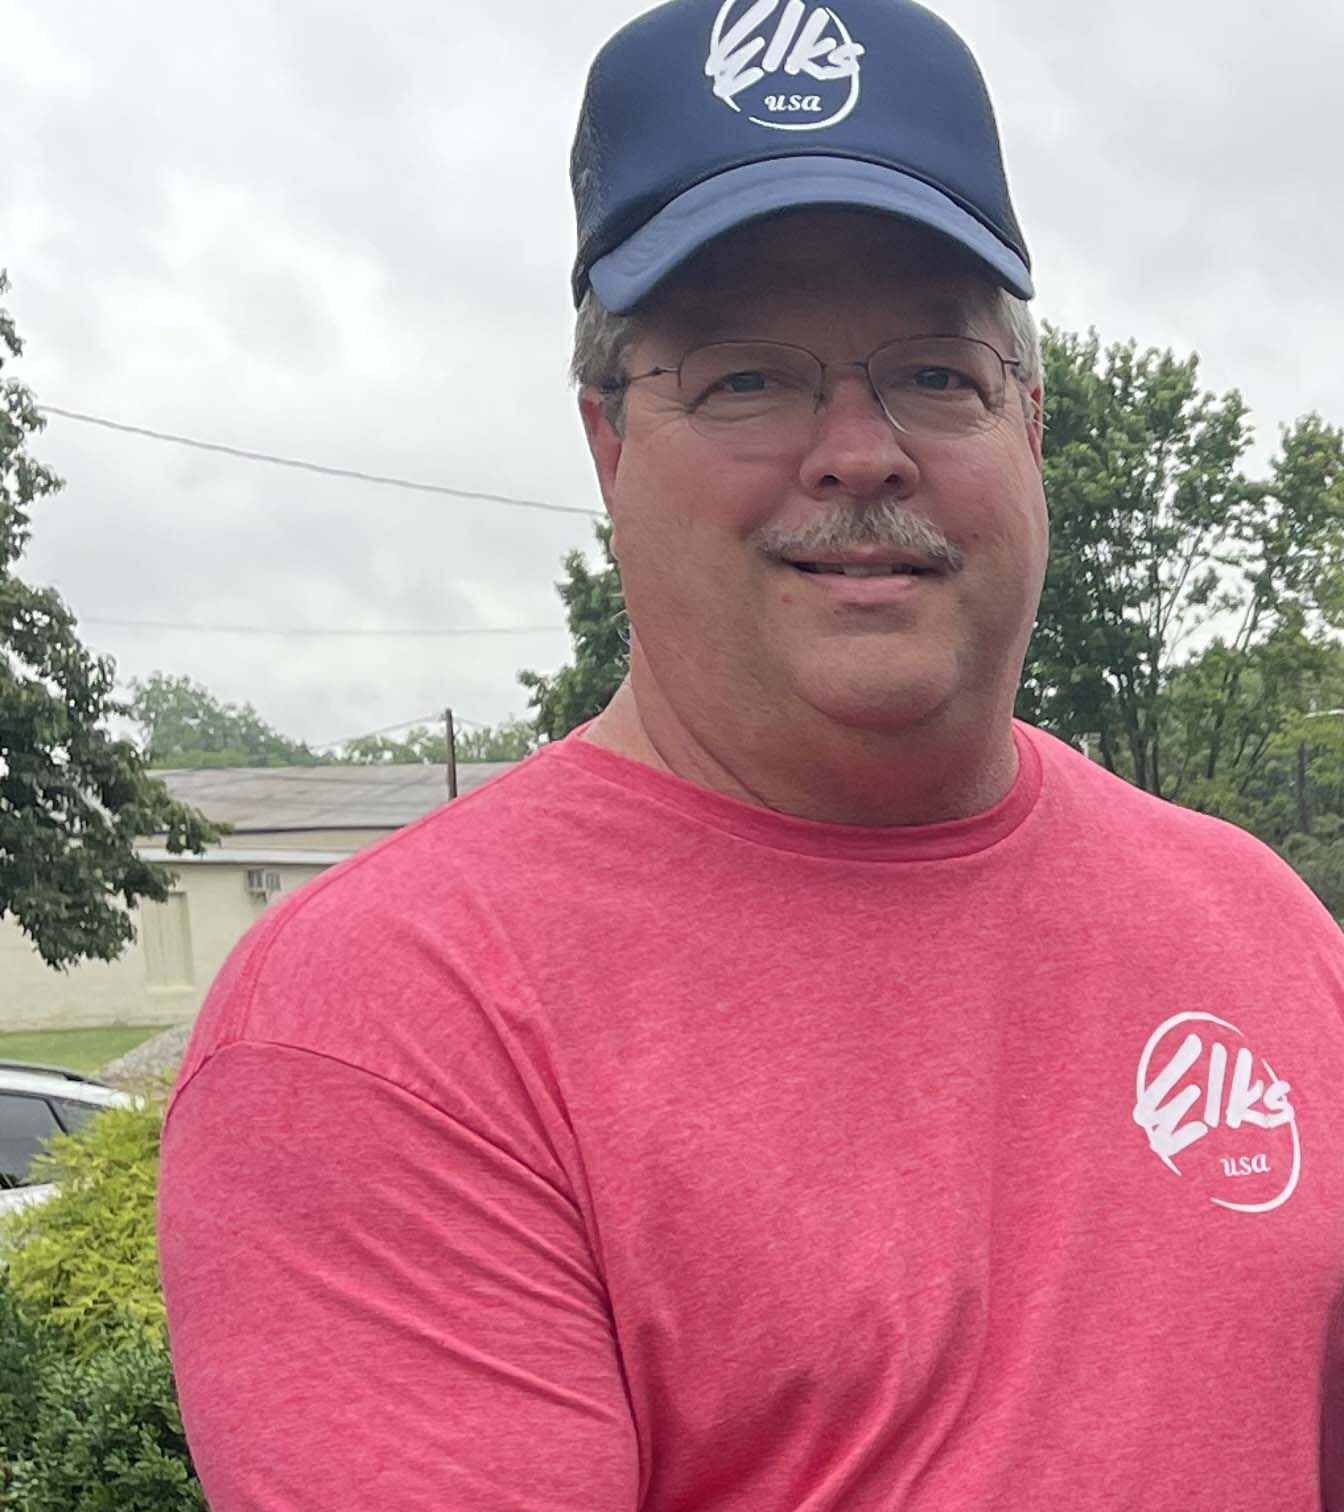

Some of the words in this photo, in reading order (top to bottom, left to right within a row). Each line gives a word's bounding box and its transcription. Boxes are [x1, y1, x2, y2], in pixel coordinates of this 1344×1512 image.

[704, 0, 865, 98] Elks
[764, 93, 822, 114] usa
[1132, 1033, 1296, 1158] Elks
[1219, 1152, 1271, 1177] usa
